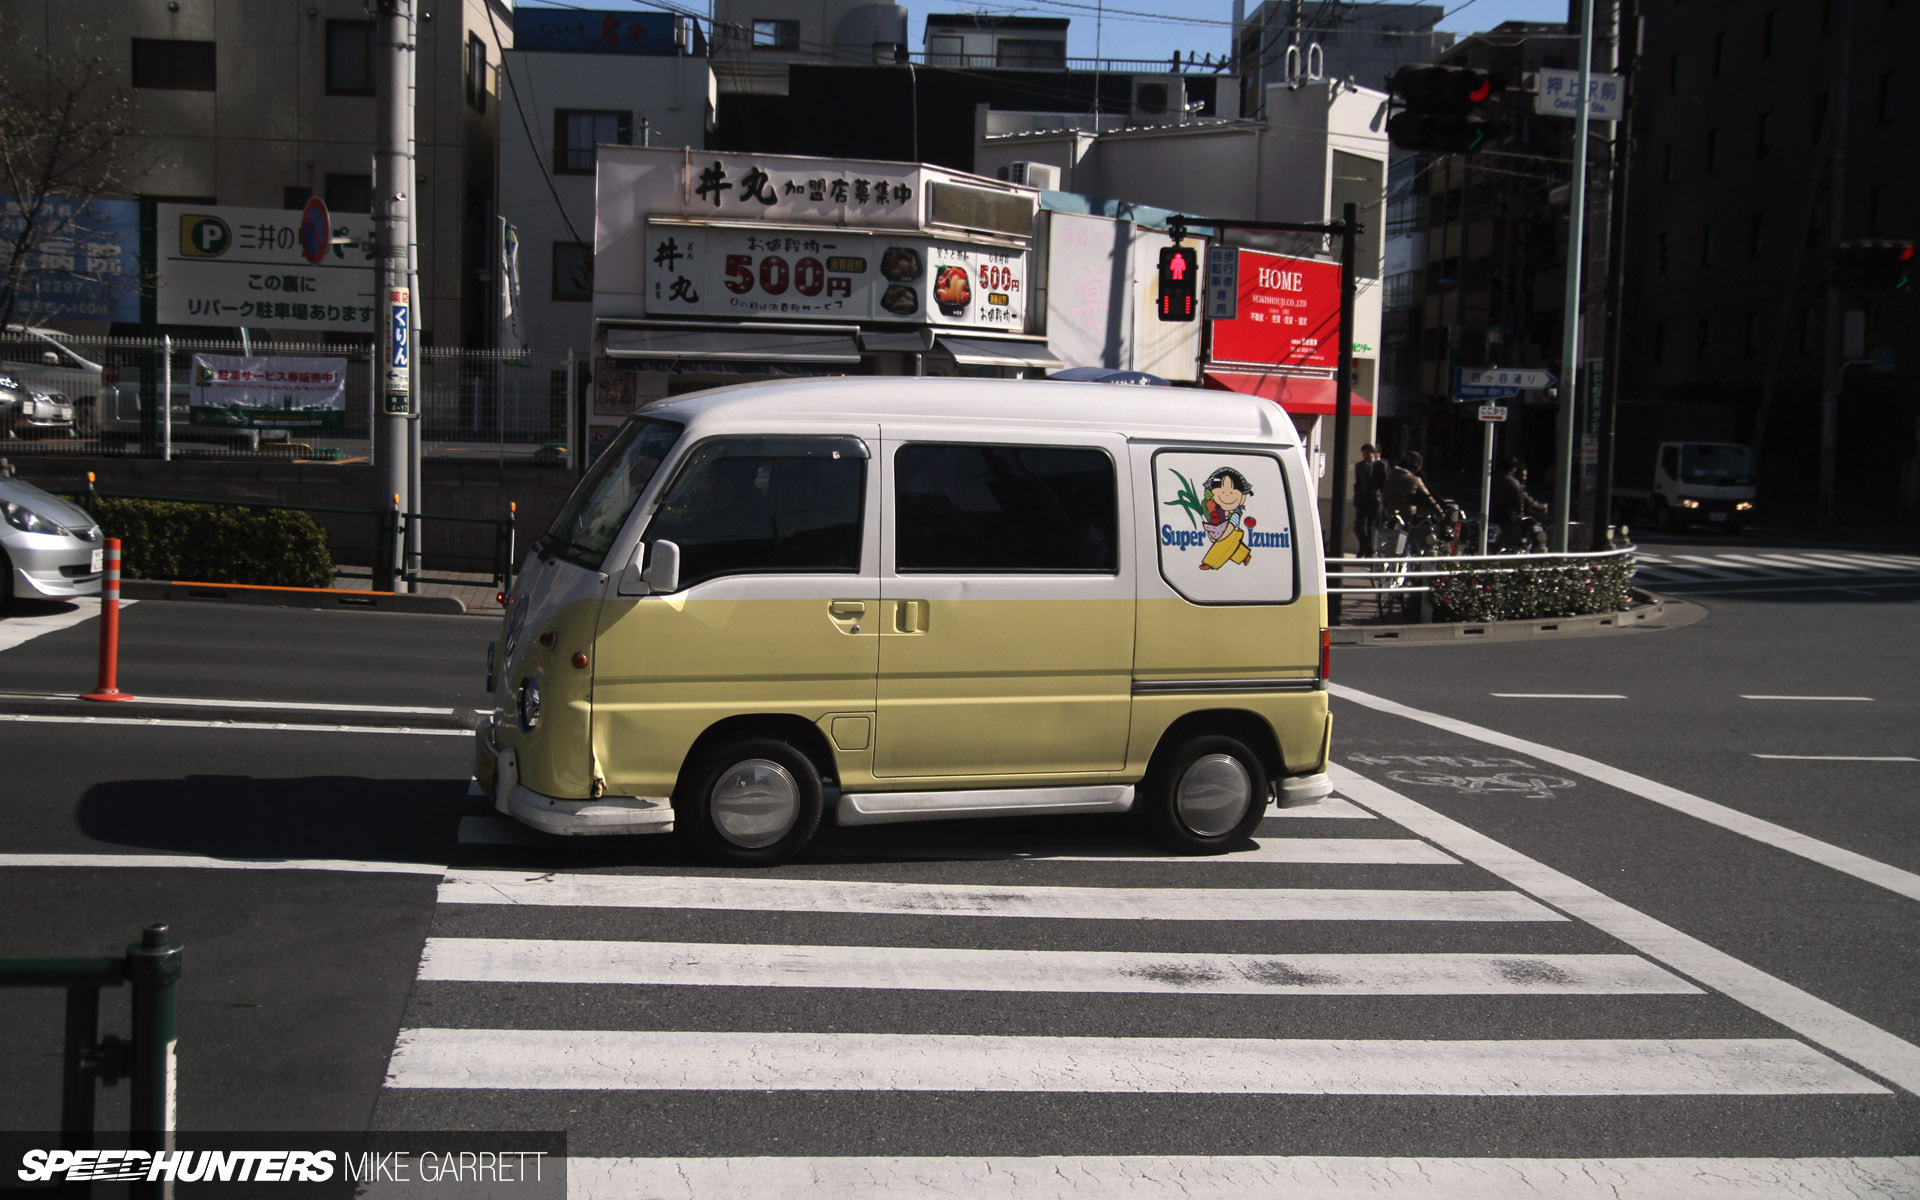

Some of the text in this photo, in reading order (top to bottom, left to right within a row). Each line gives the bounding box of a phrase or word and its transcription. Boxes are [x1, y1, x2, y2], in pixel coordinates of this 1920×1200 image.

[695, 161, 912, 207] 丼丸 加盟店募集中
[249, 275, 316, 292] この裏に
[1258, 267, 1303, 293] HOME
[188, 299, 375, 322] リパーク駐車場あります
[394, 308, 408, 365] くりん
[1161, 524, 1290, 551] Super Izumi
